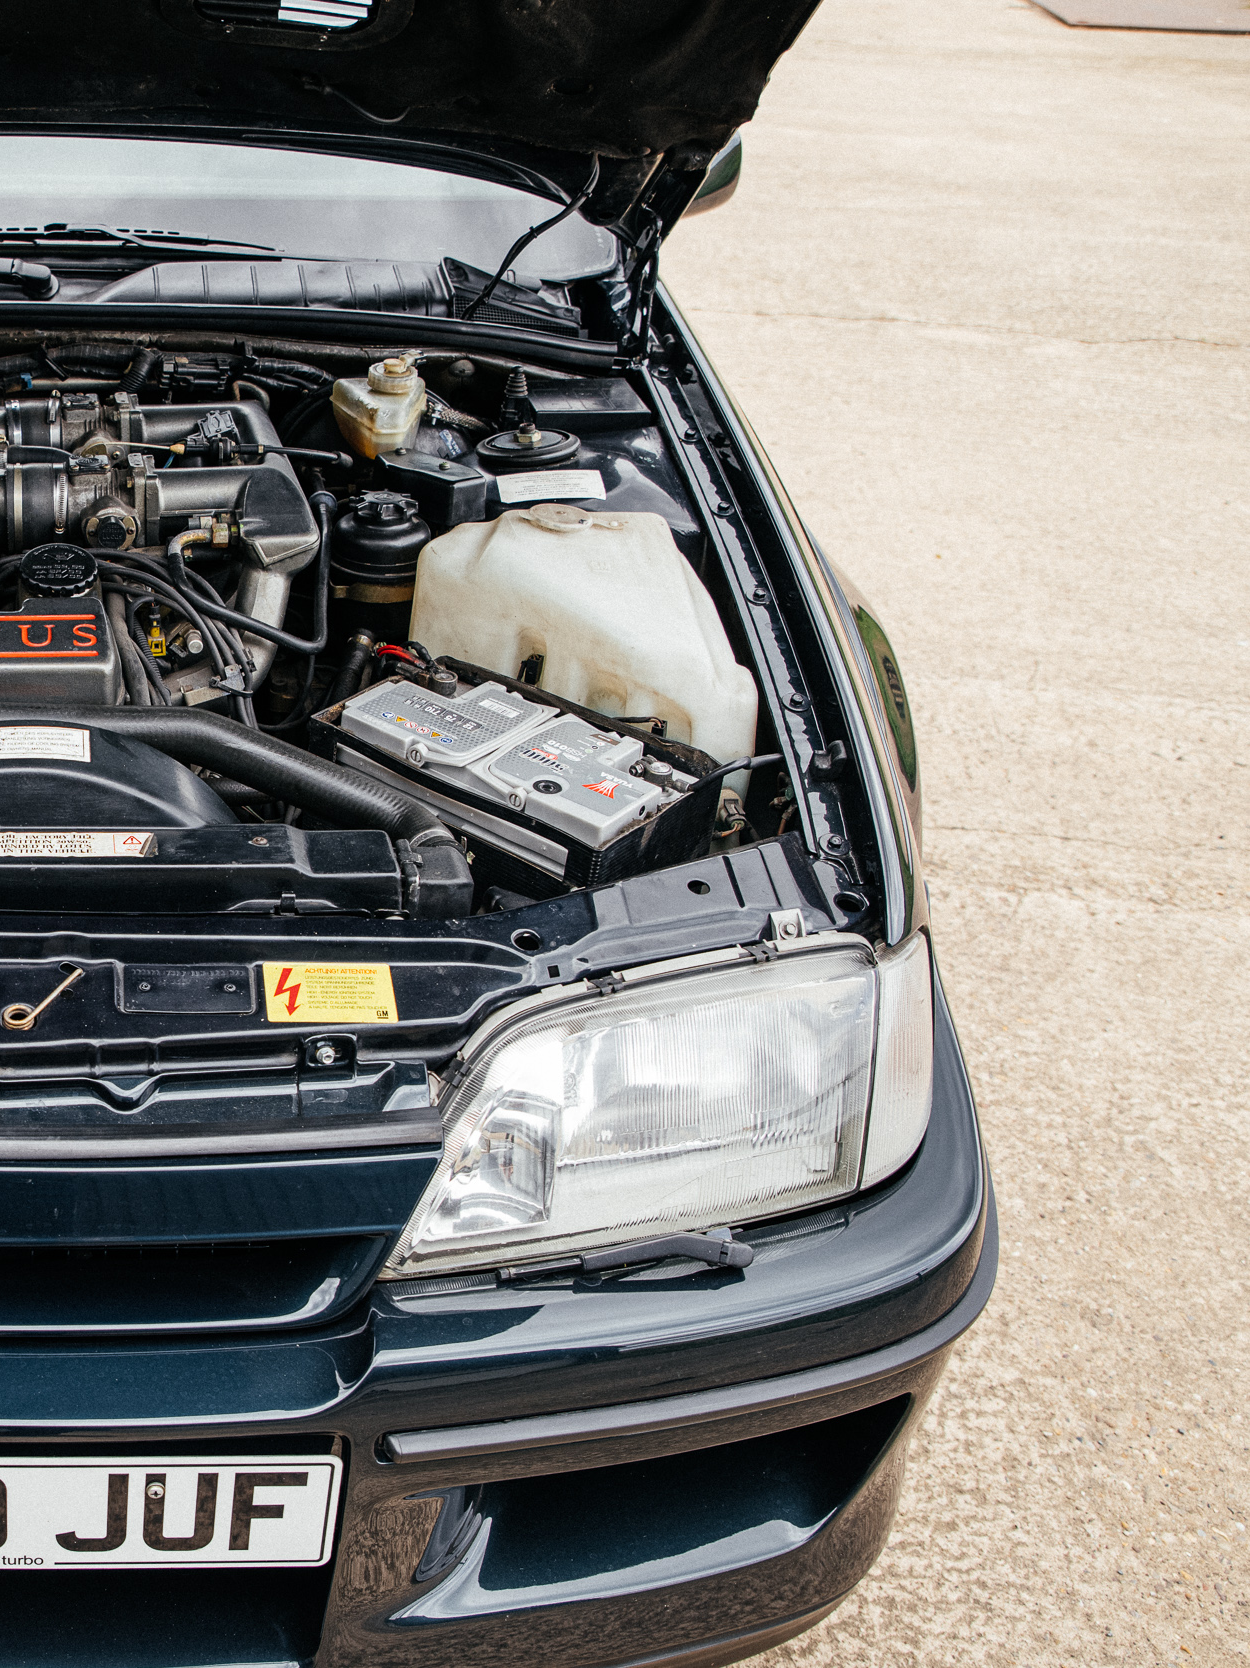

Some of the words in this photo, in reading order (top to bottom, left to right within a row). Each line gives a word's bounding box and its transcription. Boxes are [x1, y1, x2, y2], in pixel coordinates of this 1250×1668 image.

[424, 706, 441, 716] 710
[600, 771, 634, 788] YUASA
[55, 1472, 309, 1552] JUF
[1, 1555, 44, 1566] turbo
